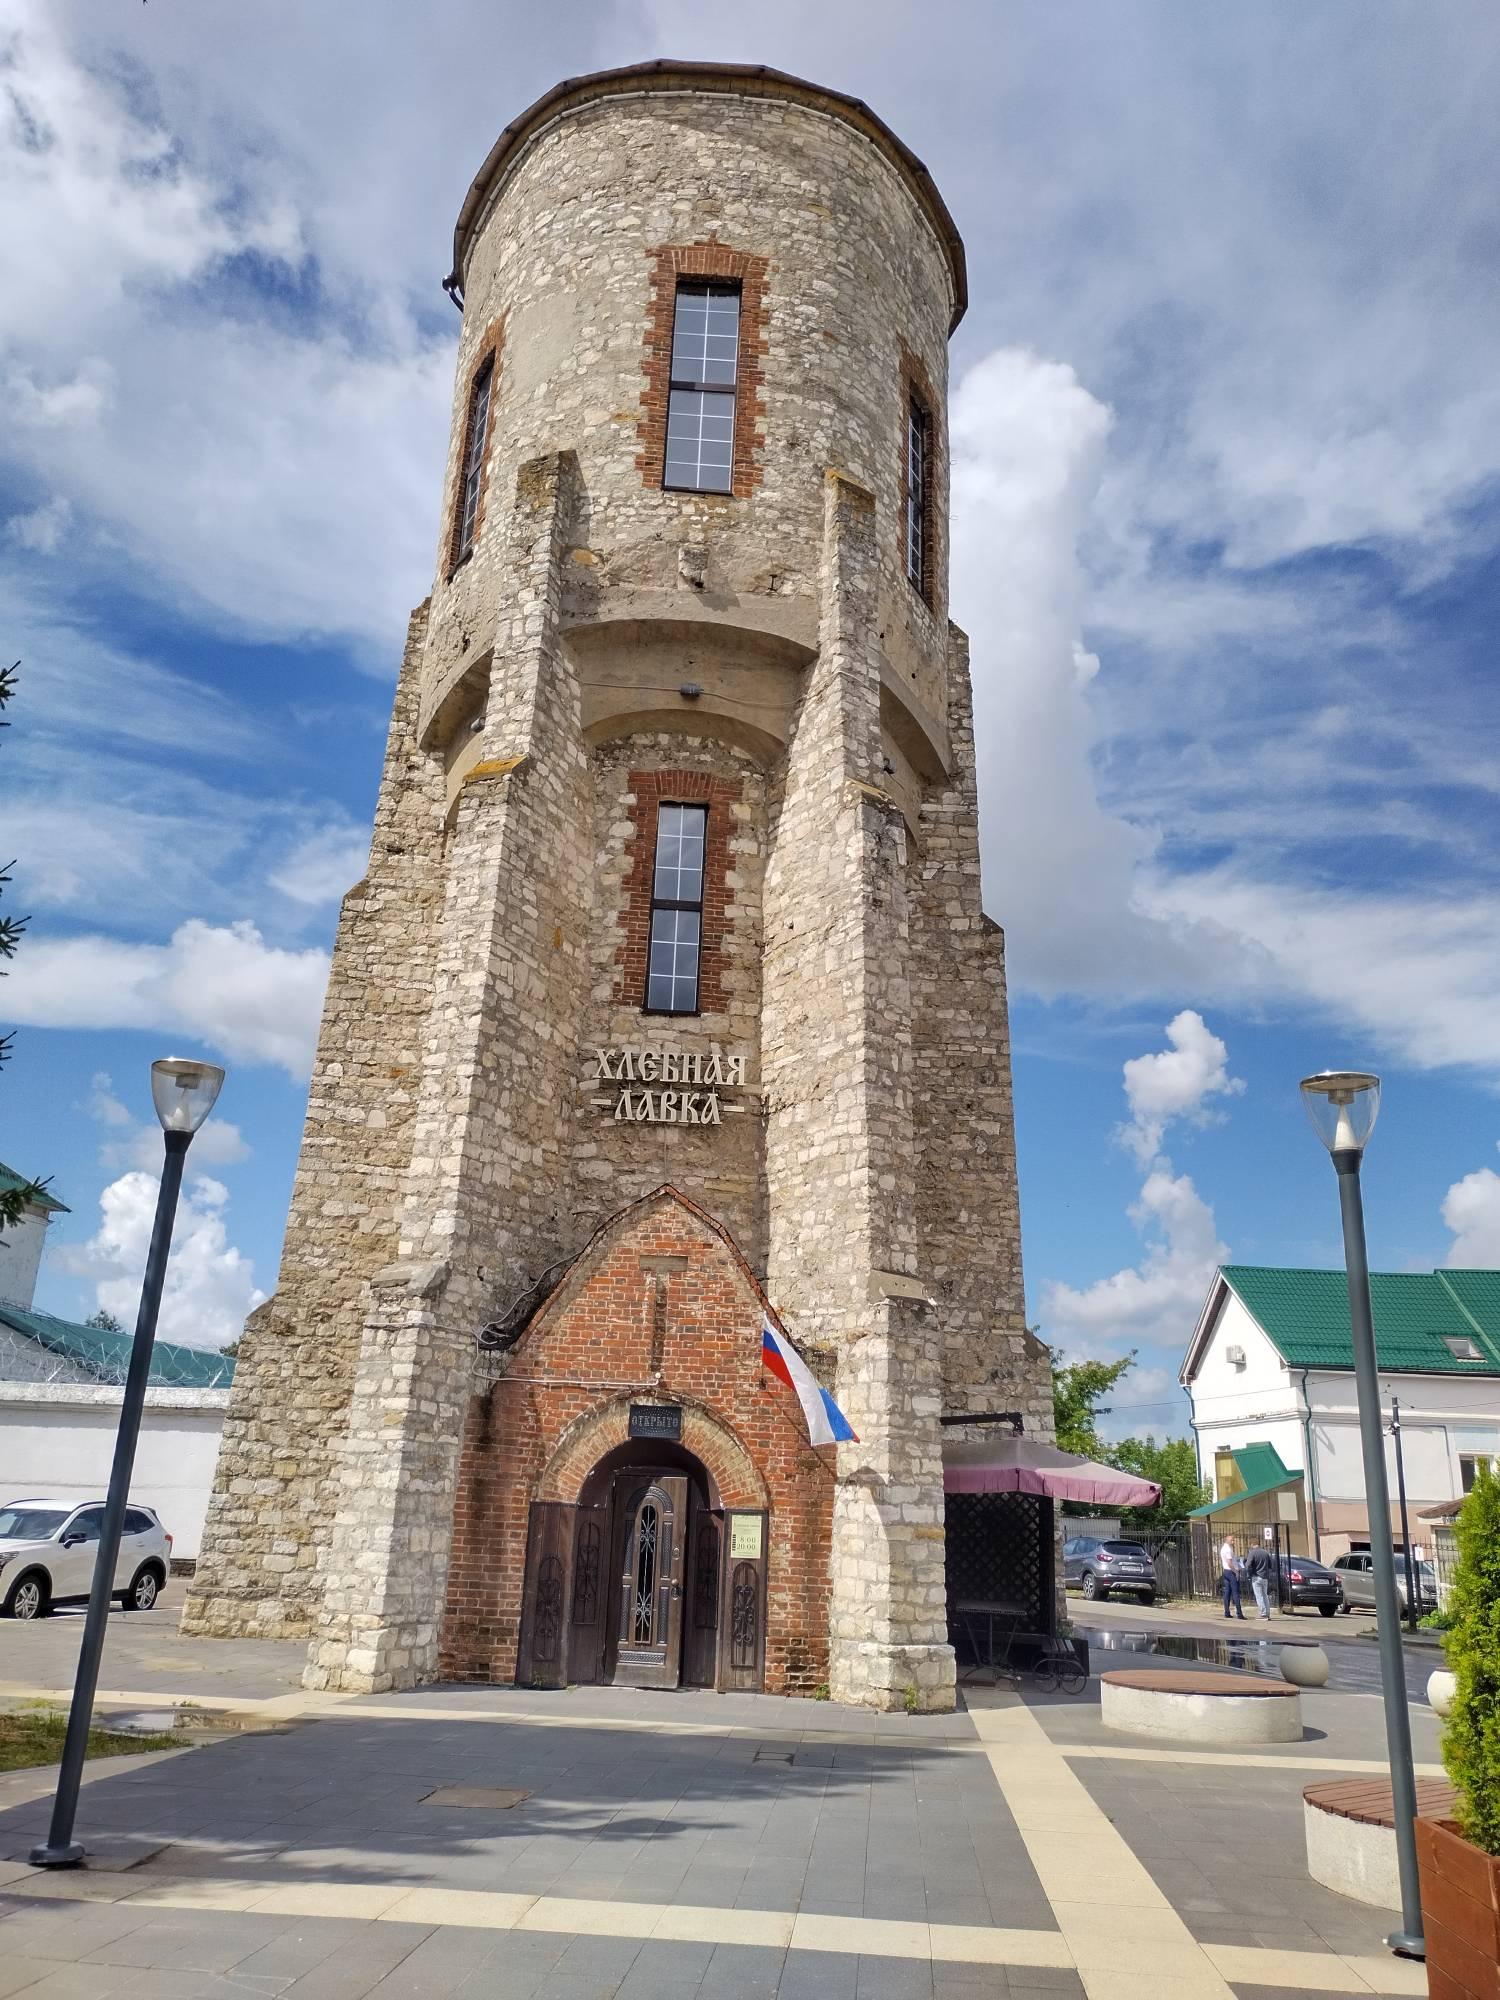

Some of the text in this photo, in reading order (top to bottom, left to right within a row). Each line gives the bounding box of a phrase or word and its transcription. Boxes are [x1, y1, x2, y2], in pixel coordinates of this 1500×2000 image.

[593, 1049, 748, 1086] ХЛЕБНАЯ
[614, 1089, 723, 1125] ЛАВКА
[631, 1415, 679, 1428] ОТКРЫТО
